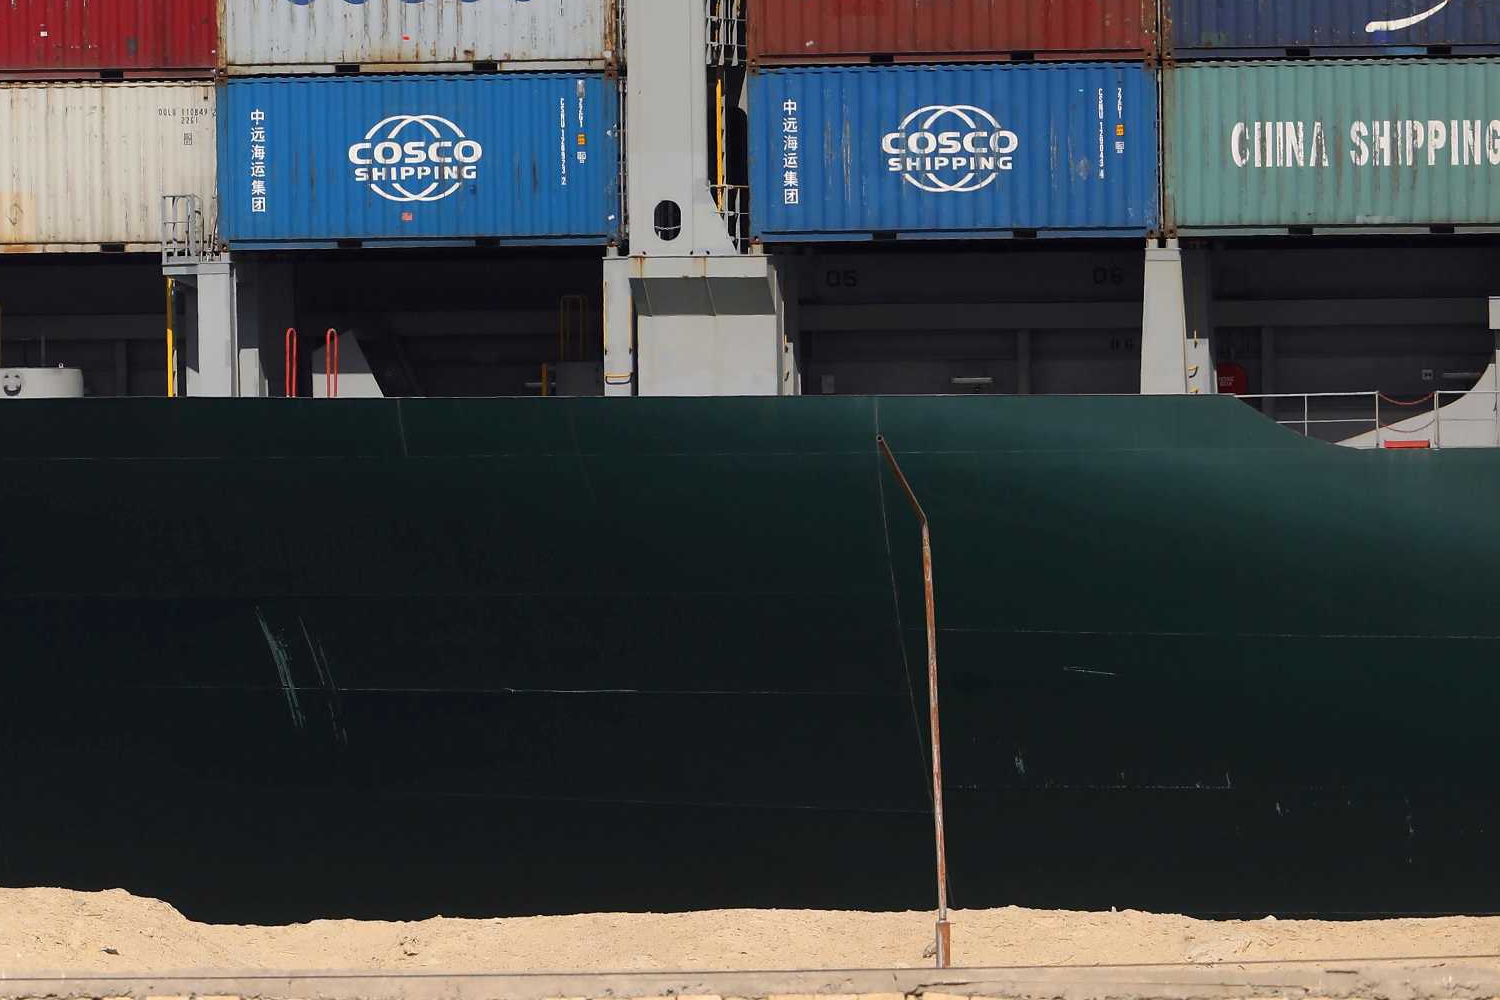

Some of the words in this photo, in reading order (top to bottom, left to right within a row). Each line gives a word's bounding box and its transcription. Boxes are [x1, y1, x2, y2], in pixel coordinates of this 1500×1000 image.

[348, 140, 483, 165] COSCO
[783, 99, 799, 205] 中远海运集团
[881, 131, 1019, 155] COSCO
[1350, 119, 1500, 167] SHIPPING
[250, 109, 267, 213] 中远海运集团
[355, 165, 477, 182] SHIPPING
[888, 156, 1013, 172] SHIPPING
